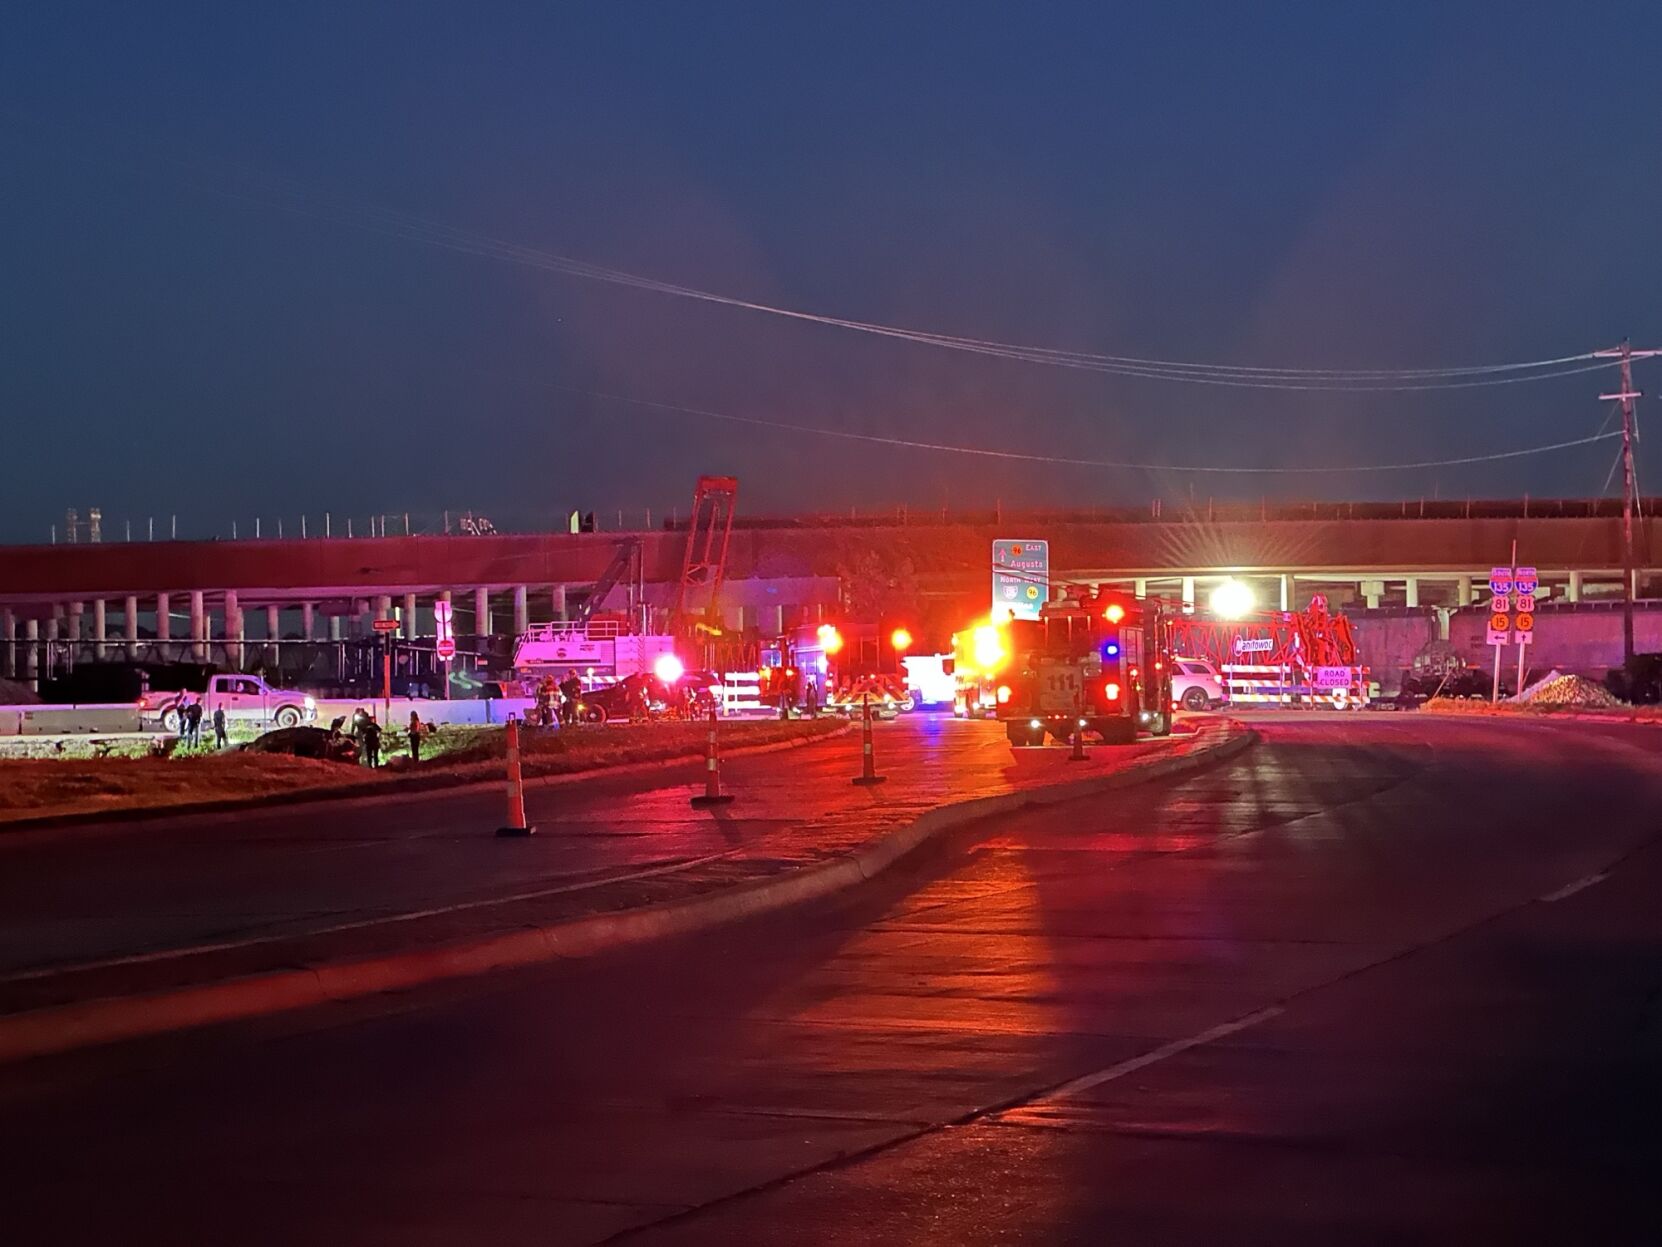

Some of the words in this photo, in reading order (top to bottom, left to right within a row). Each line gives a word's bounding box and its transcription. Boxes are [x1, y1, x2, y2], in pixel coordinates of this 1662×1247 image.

[1012, 547, 1022, 555] 96
[1010, 560, 1043, 569] Augusta
[1028, 588, 1037, 596] 96
[1494, 582, 1509, 592] 135
[1519, 582, 1534, 592] 135
[1495, 599, 1506, 609] 81
[1520, 599, 1531, 609] 81
[1496, 617, 1506, 628] 15
[1520, 617, 1530, 627] 15
